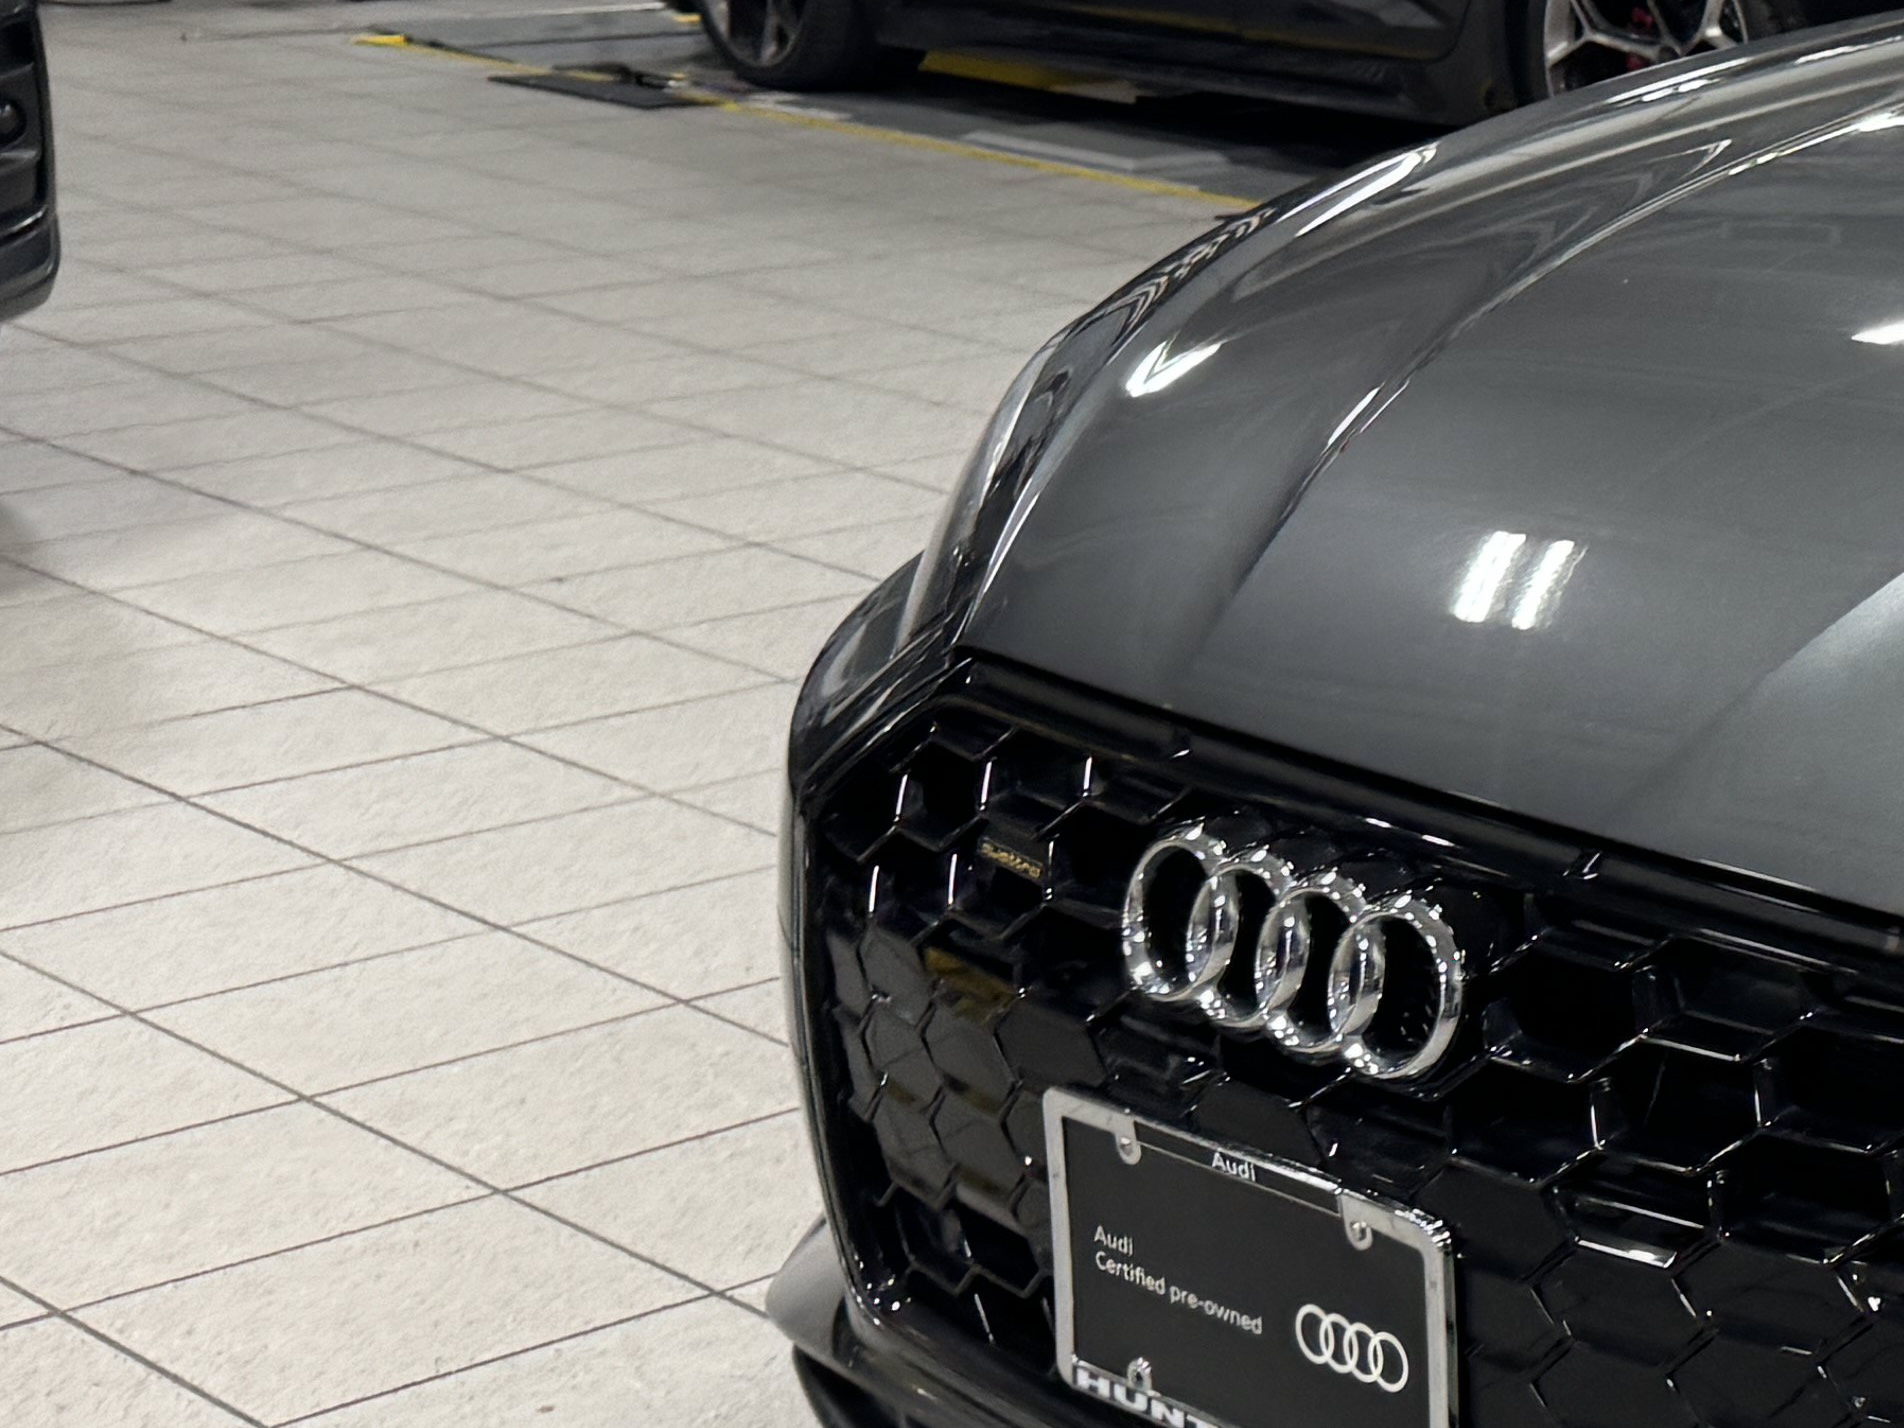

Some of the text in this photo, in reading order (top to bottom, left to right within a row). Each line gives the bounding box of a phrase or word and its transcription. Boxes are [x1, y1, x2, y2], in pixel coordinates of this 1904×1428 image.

[1211, 1151, 1257, 1181] Audi
[1093, 1224, 1134, 1257] Audi
[1095, 1250, 1263, 1335] Certified pre-owned
